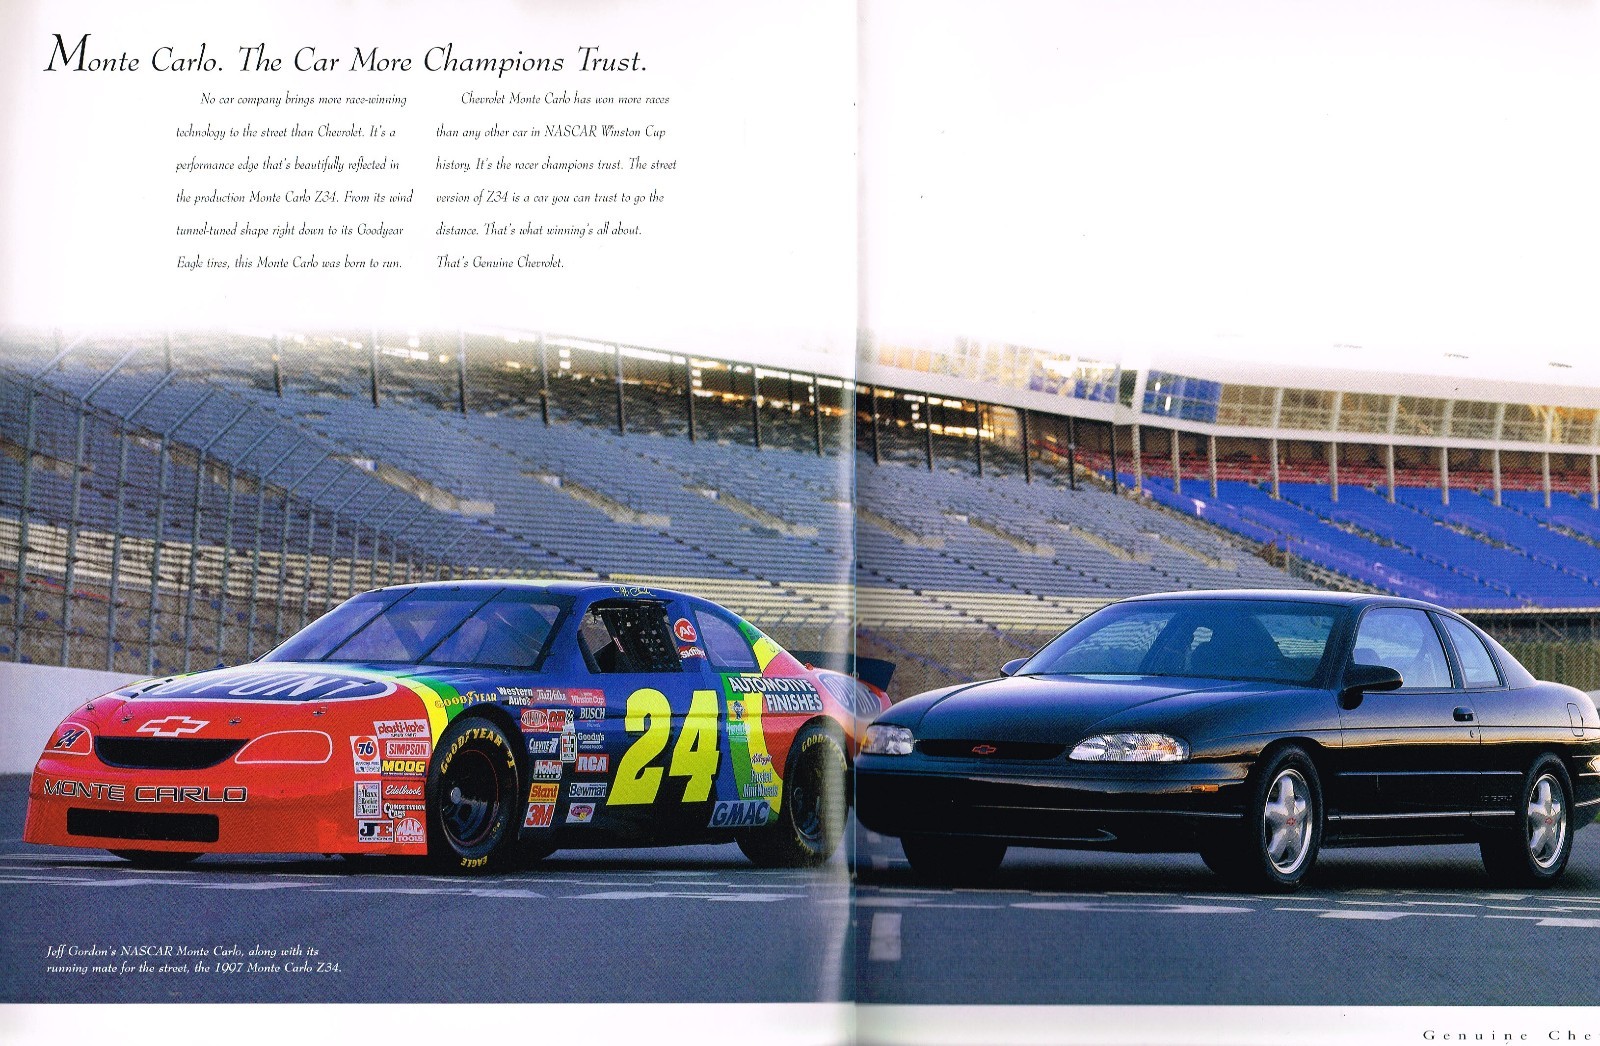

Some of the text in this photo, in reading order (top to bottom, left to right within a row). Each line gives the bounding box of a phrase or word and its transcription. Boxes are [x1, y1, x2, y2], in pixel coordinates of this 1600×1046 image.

[42, 33, 646, 79] Monte Carlo. The Car More Champions Trust.
[200, 90, 407, 108] No car company brings more race-winning
[461, 89, 506, 105] Chevrolet
[509, 91, 541, 104] Monte
[544, 89, 571, 105] Carlo
[573, 90, 592, 104] has
[176, 122, 226, 141] technology
[229, 127, 240, 137] to
[242, 123, 258, 137] the
[260, 127, 287, 138] street
[291, 122, 314, 138] than
[317, 122, 365, 138] Chevrolet.
[369, 124, 386, 137] It's
[436, 122, 459, 137] than
[462, 130, 482, 141] any
[484, 122, 510, 137] other
[530, 126, 541, 137] in
[544, 124, 597, 138] NASCAR
[601, 124, 641, 137] Winston
[645, 124, 666, 139] Cup
[175, 155, 400, 174] performance edge that's beautifully reflected in
[435, 155, 677, 173] history. It's the racer champions trust. The street
[176, 188, 414, 206] the production Monte Carlo Z34. From its wind
[436, 188, 665, 206] version of Z34 is a car you can trust to go the
[176, 221, 404, 239] tunnel-tuned shape right down to its Goodyear
[435, 220, 642, 239] distance. That's what winning's all about.
[177, 253, 402, 272] Eagle tires, this Monte Carlo was born to run.
[436, 253, 564, 268] That's Genuine Chevrolet.
[680, 625, 695, 637] AC
[496, 686, 533, 697] Western
[728, 676, 817, 693] AUTOMOTIVE
[571, 695, 606, 706] Winston Cup
[766, 693, 824, 713] FINISHES
[579, 707, 606, 720] BUSCH
[54, 729, 86, 749] 24
[577, 732, 605, 743] Goody's
[357, 740, 375, 756] 76
[388, 743, 428, 756] SIMPSON
[440, 727, 503, 775] GOODYEAR
[606, 687, 720, 806] 24
[381, 760, 427, 773] MOOG
[577, 755, 607, 772] RCA
[43, 779, 248, 803] MONTE CARLO
[530, 784, 558, 798] Stant
[569, 783, 607, 797] Bowman
[525, 804, 555, 827] 3M
[712, 800, 770, 826] GMAC
[460, 855, 488, 868] EAGLE
[46, 943, 319, 959] Jeff Gordon's NASCAR Monte Carlo, along with its
[46, 960, 342, 975] running mate for the street, the 1997 Monte Carlo Z34.
[1422, 1029, 1600, 1041] Genuine Che
